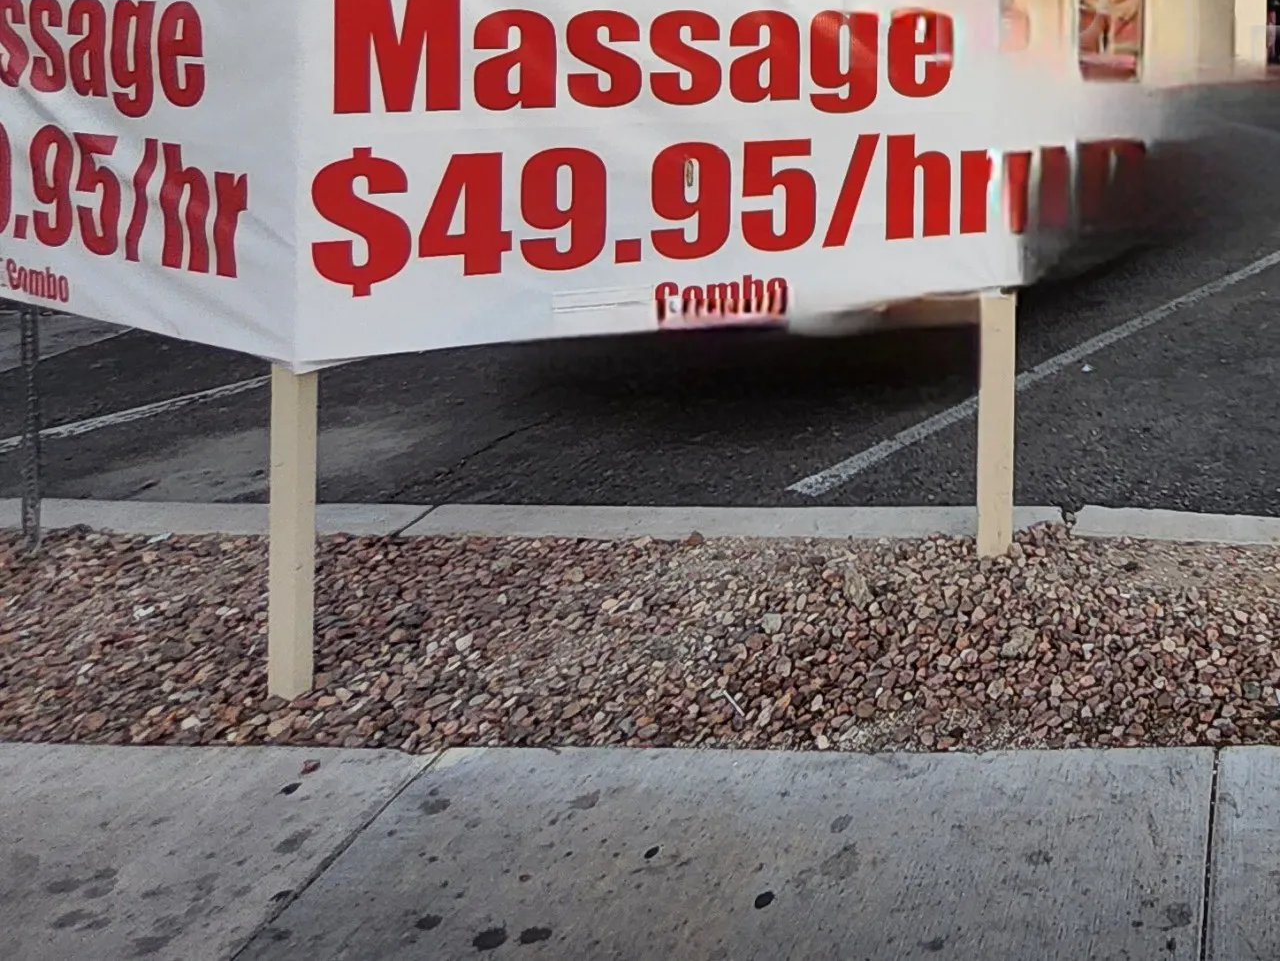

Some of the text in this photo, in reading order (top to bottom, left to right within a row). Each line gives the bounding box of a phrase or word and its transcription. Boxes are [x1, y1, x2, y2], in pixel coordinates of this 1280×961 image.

[0, 123, 248, 278] .95/hr
[311, 133, 990, 298] $49.95/hr
[6, 258, 70, 303] Combo
